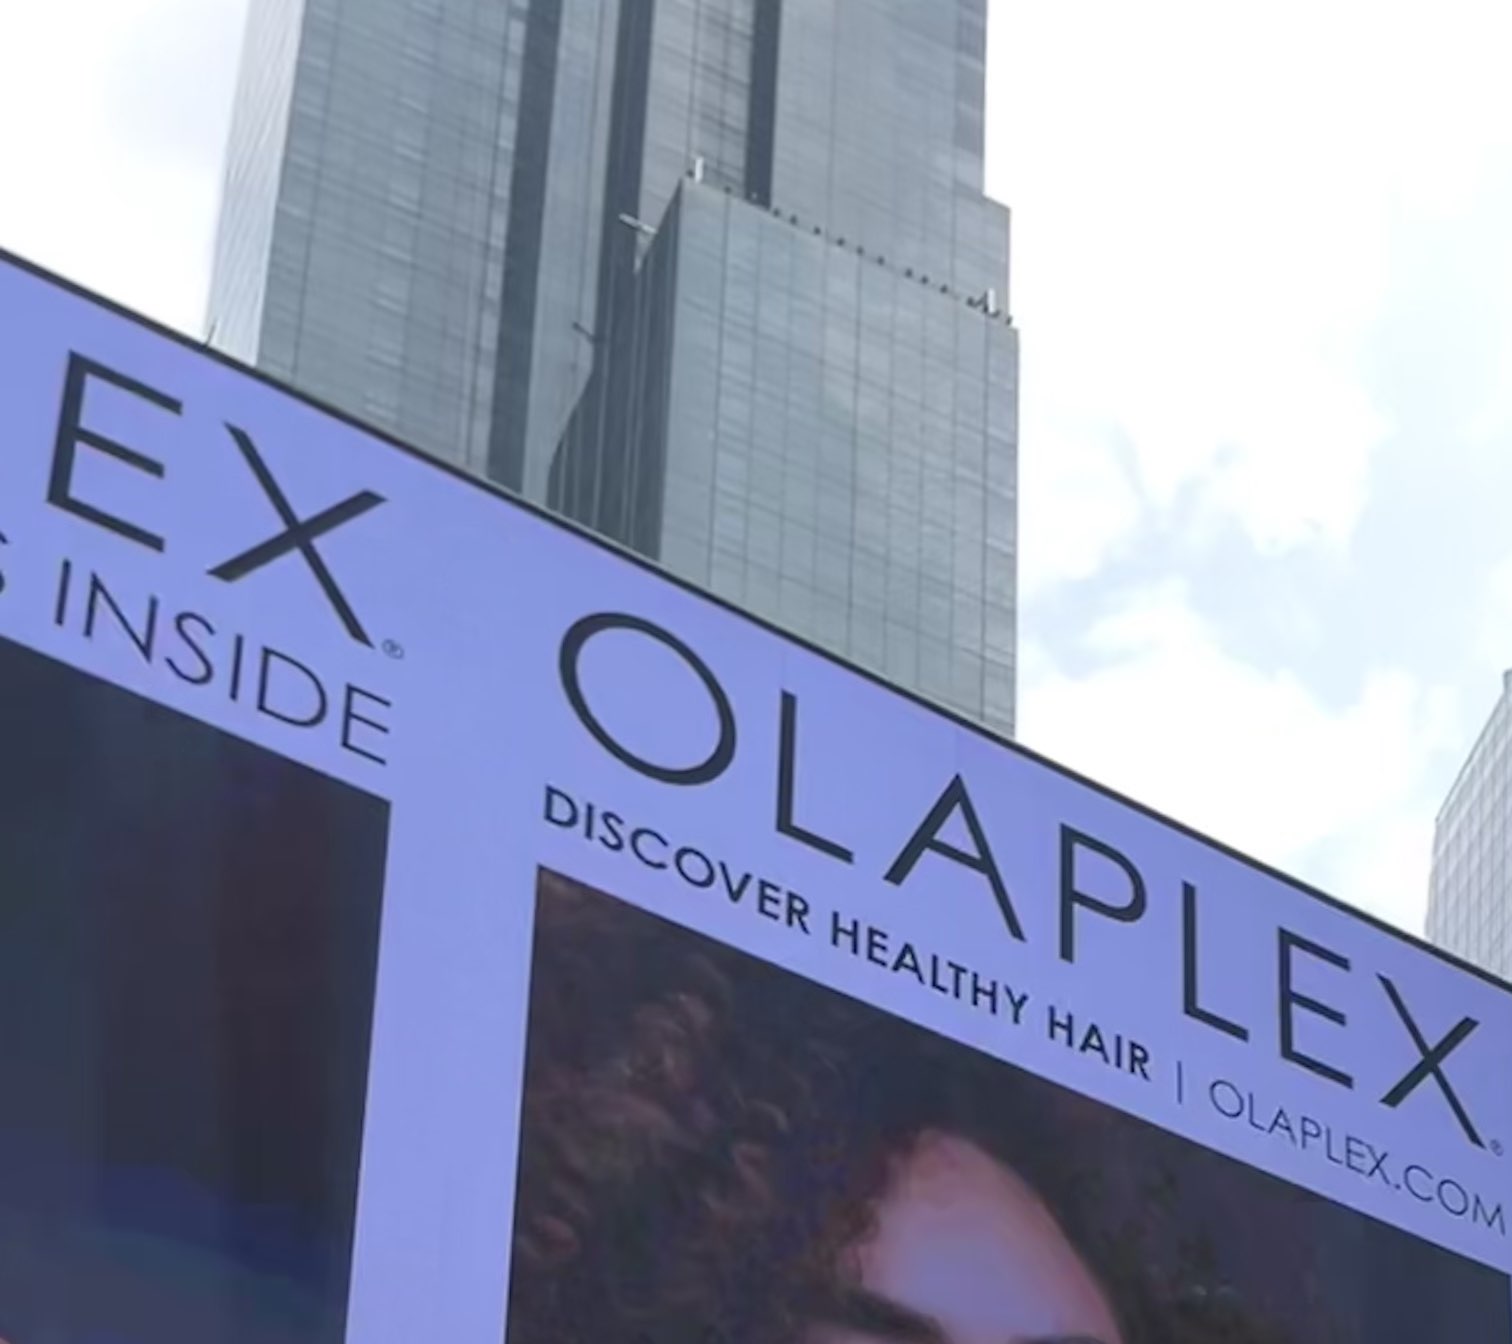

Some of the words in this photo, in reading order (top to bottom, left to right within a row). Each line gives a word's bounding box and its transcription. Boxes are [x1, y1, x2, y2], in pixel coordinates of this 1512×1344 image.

[55, 559, 392, 766] INSIDE
[557, 611, 1487, 1150] OLAPLEX
[543, 785, 810, 935] DISCOVER
[832, 911, 1028, 1027] HEALTHY
[1048, 1006, 1151, 1081] HAIR
[1209, 1078, 1506, 1237] OLAPLEX.COM
